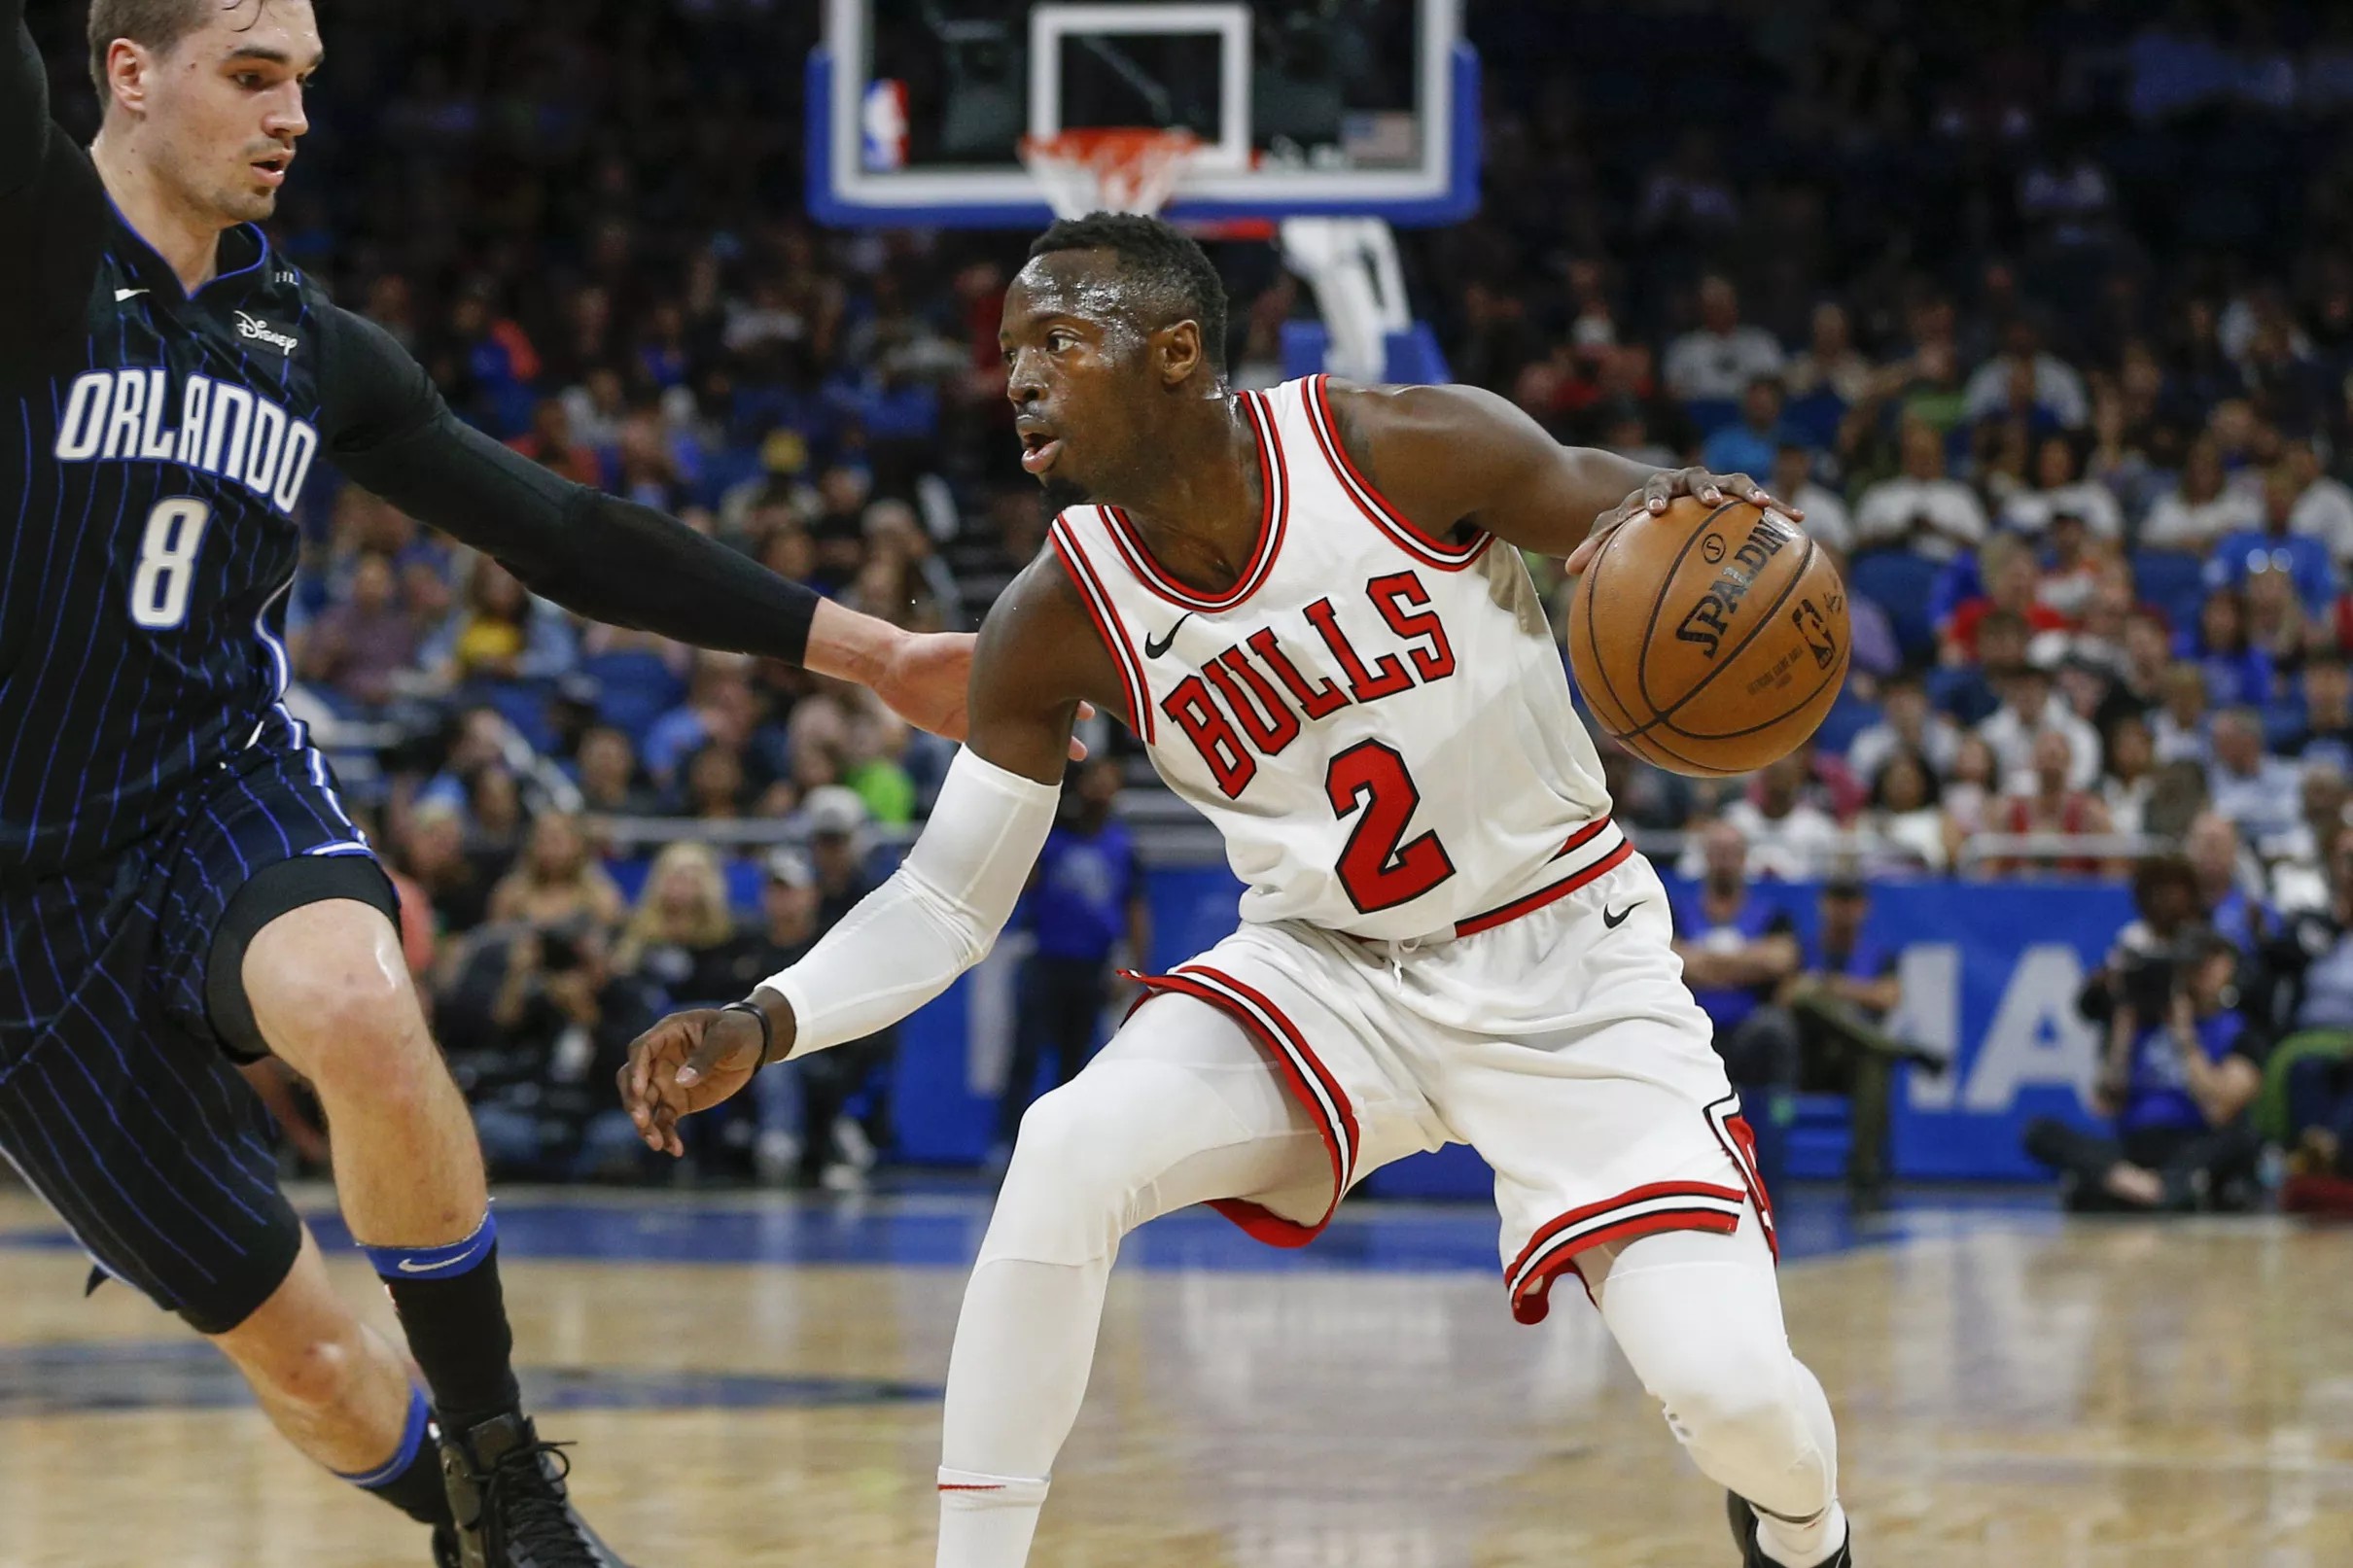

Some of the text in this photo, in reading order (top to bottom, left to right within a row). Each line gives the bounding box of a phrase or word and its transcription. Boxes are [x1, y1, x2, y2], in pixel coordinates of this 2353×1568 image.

[233, 310, 299, 356] Disney
[55, 368, 318, 513] ORLANDO
[131, 497, 210, 626] 8
[1675, 507, 1795, 659] SPALDIN
[1160, 570, 1457, 800] BULLS
[1324, 737, 1457, 915] 2
